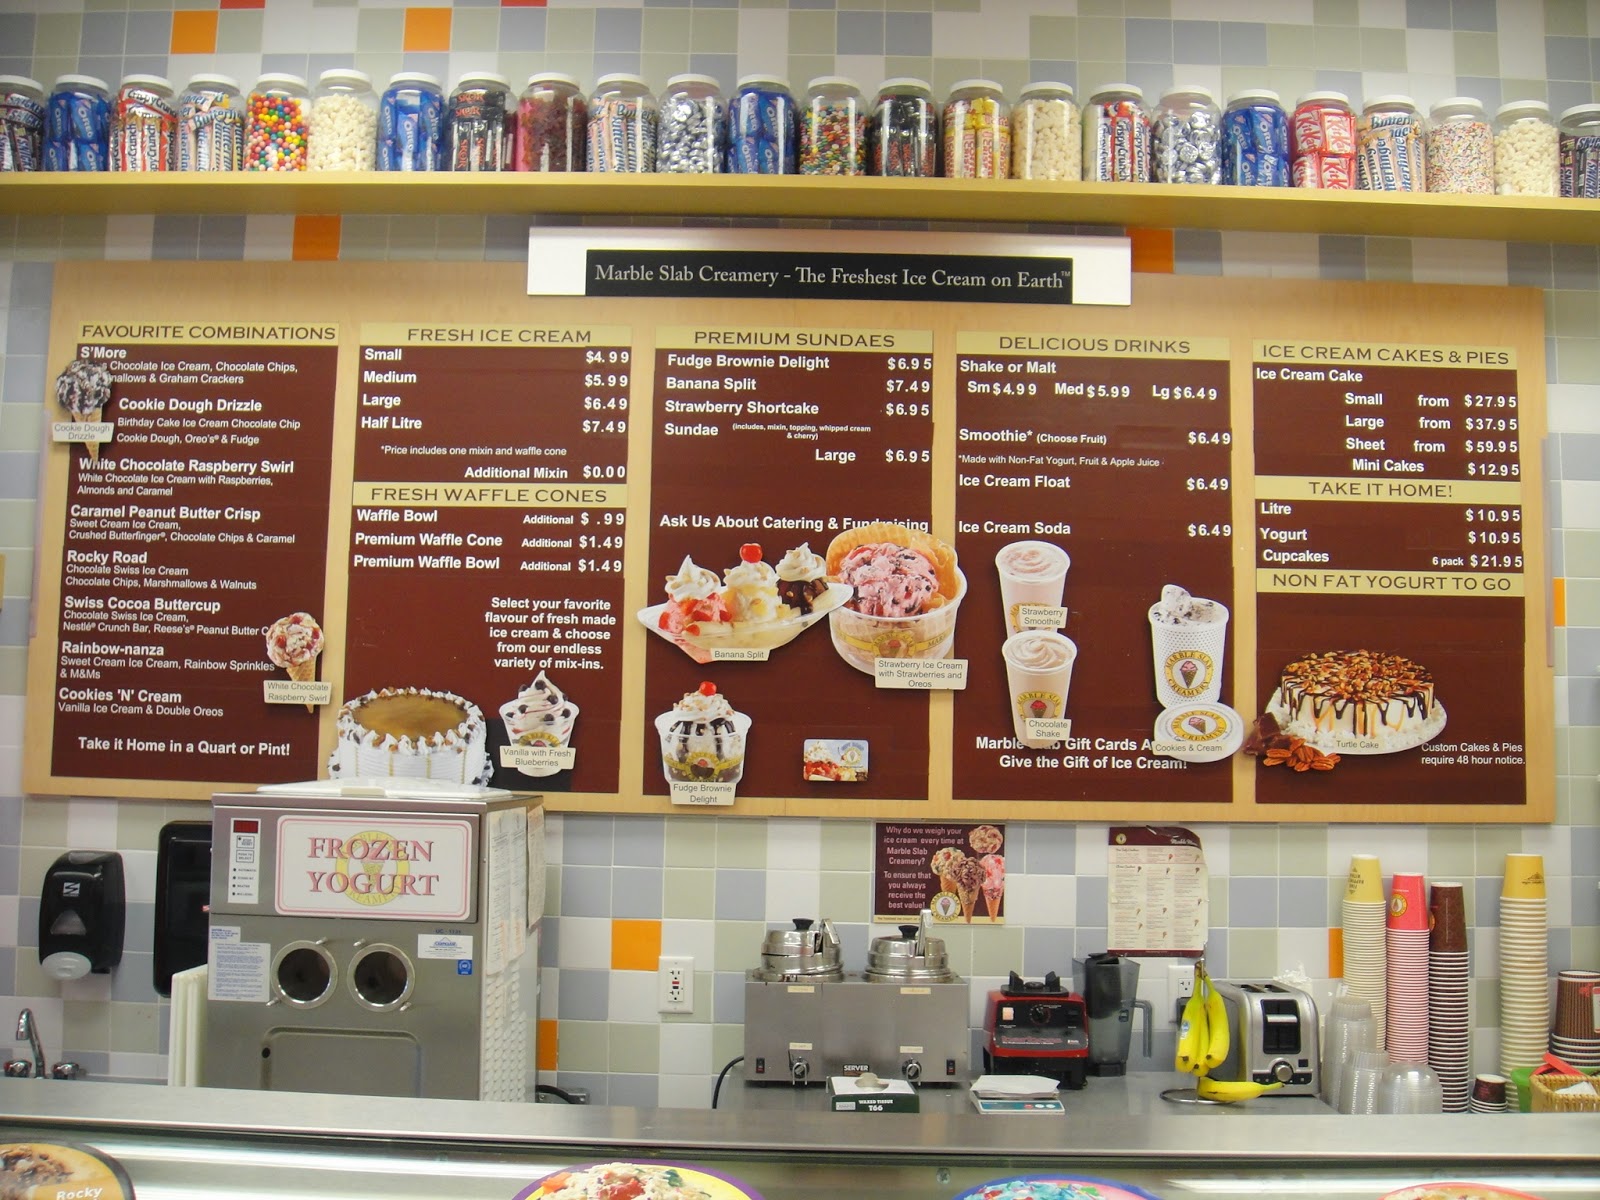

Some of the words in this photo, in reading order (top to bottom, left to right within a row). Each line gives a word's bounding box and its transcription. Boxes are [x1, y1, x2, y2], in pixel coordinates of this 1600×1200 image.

[594, 264, 654, 281] Marble
[659, 264, 693, 281] Slab
[698, 265, 779, 287] Creamery
[795, 266, 825, 283] The
[831, 267, 897, 285] Freshest
[902, 268, 926, 285] Ice
[931, 269, 986, 286] Cream
[991, 276, 1012, 287] on
[82, 324, 184, 338] FAVOURITE
[188, 325, 335, 340] COMBINATIONS
[407, 328, 474, 341] FRESH
[480, 329, 512, 342] ICE
[518, 329, 591, 343] CREAM
[694, 331, 790, 345] PREMIUM
[796, 332, 895, 348] SUNDAES
[80, 346, 127, 359] S'More
[999, 336, 1108, 351] DELICIOUS
[1114, 339, 1190, 354] DRINKS
[364, 347, 402, 361] Small
[585, 350, 629, 364] $4.99
[667, 353, 712, 369] Fudge
[716, 354, 775, 368] Brownie
[778, 355, 829, 371] Delight
[887, 356, 932, 370] $6.95
[1263, 344, 1295, 358] ICE
[1300, 346, 1371, 360] CREAM
[1377, 348, 1443, 363] CAKES
[1448, 350, 1461, 363] &
[1466, 351, 1509, 365] PIES
[960, 359, 1004, 373] Shake
[1007, 363, 1023, 373] or
[1026, 360, 1057, 374] Malt
[363, 370, 417, 383] Medium
[584, 373, 628, 387] $5.99
[666, 376, 719, 390] Banana
[723, 377, 756, 393] Split
[886, 379, 930, 393] $7.49
[967, 380, 990, 393] Sm
[992, 382, 1036, 396] $4.99
[1054, 382, 1083, 395] Med
[1086, 384, 1130, 398] $5.99
[1152, 384, 1170, 400] Lg
[1173, 385, 1217, 400] $6.49
[118, 397, 165, 410] Cookie
[168, 398, 213, 414] Dough
[216, 398, 262, 412] Drizzle
[362, 393, 401, 409] Large
[584, 396, 627, 410] $6.49
[664, 399, 743, 416] Strawberry
[746, 400, 819, 414] Shortcake
[885, 402, 929, 416] $6.95
[1344, 392, 1383, 405] Small
[1417, 394, 1449, 407] from
[1464, 393, 1516, 408] $27.95
[117, 417, 155, 429] Birthday
[156, 417, 181, 427] Cake
[182, 417, 197, 427] Ice
[198, 417, 229, 428] Cream
[231, 418, 277, 429] Chocolate
[278, 418, 301, 431] Chip
[361, 416, 389, 429] Half
[391, 416, 422, 429] Litre
[582, 419, 626, 433] $7.49
[664, 422, 718, 436] Sundae
[1036, 433, 1078, 444] (Choose
[1080, 434, 1107, 445] Fruit)
[1188, 431, 1231, 445] $6.49
[815, 448, 856, 464] Large
[885, 448, 930, 463] $6.95
[119, 457, 185, 472] Chocolate
[188, 459, 257, 475] Raspberry
[260, 460, 294, 473] Swirl
[464, 466, 530, 478] Additional
[533, 467, 568, 479] Mixin
[582, 464, 625, 479] $0.00
[371, 487, 437, 501] FRESH
[443, 488, 529, 502] WAFFLE
[534, 489, 607, 503] CONES
[1308, 481, 1361, 495] TAKE
[1367, 483, 1383, 496] IT
[1388, 483, 1452, 498] HOME!
[70, 504, 125, 518] Caramel
[128, 505, 176, 518] Peanut
[179, 506, 221, 519] Butter
[224, 506, 261, 523] Crisp
[356, 508, 400, 522] Waffle
[403, 509, 438, 522] Bowl
[522, 514, 574, 524] Additional
[958, 520, 979, 533] Ice
[983, 520, 1030, 534] Cream
[1034, 521, 1071, 535] Soda
[1187, 523, 1231, 537] $6.49
[1259, 527, 1307, 543] Yogurt
[1468, 530, 1520, 544] $10.95
[355, 532, 415, 545] Premium
[419, 532, 463, 546] Waffle
[466, 533, 503, 546] Cone
[521, 537, 572, 548] Additional
[578, 534, 623, 549] $1.49
[67, 549, 109, 566] Rocky
[112, 550, 147, 564] Road
[1262, 548, 1329, 564] Cupcakes
[1432, 556, 1439, 566] 6
[1440, 556, 1464, 567] pack
[1470, 553, 1523, 568] $21.95
[1273, 573, 1317, 587] NON
[1323, 574, 1361, 588] FAT
[1366, 575, 1447, 589] YOGURT
[1451, 577, 1477, 590] TO
[1482, 577, 1511, 591] GO
[64, 595, 104, 609] Swiss
[107, 596, 150, 610] Cocoa
[154, 597, 221, 614] Buttercup
[61, 640, 164, 656] Rainbow-nanza
[714, 650, 745, 658] Banana
[746, 650, 764, 659] Split
[267, 681, 289, 690] White
[290, 682, 329, 691] Chocolate
[59, 687, 113, 701] Cookies
[137, 689, 182, 703] Cream
[267, 692, 307, 703] Raspberry
[308, 693, 327, 702] Swirl
[1028, 719, 1068, 729] Chocolate
[1035, 729, 1060, 738] Shake
[77, 736, 110, 750] Take
[113, 737, 123, 750] it
[126, 738, 166, 752] Home
[169, 739, 182, 752] in
[185, 742, 194, 753] a
[197, 740, 236, 754] Quart
[239, 744, 255, 755] or
[258, 742, 290, 756] Pint!
[503, 748, 529, 756] Vanilla
[548, 749, 571, 757] Fresh
[1336, 739, 1358, 748] Turtle
[1359, 740, 1379, 749] Cake
[514, 757, 559, 767] Blueberries
[308, 837, 434, 862] FROZEN
[886, 846, 911, 855] Marble
[912, 846, 928, 855] Slab
[888, 856, 925, 866] Creamery?
[307, 869, 439, 898] YOGURT
[56, 1187, 103, 1200] Rocky
